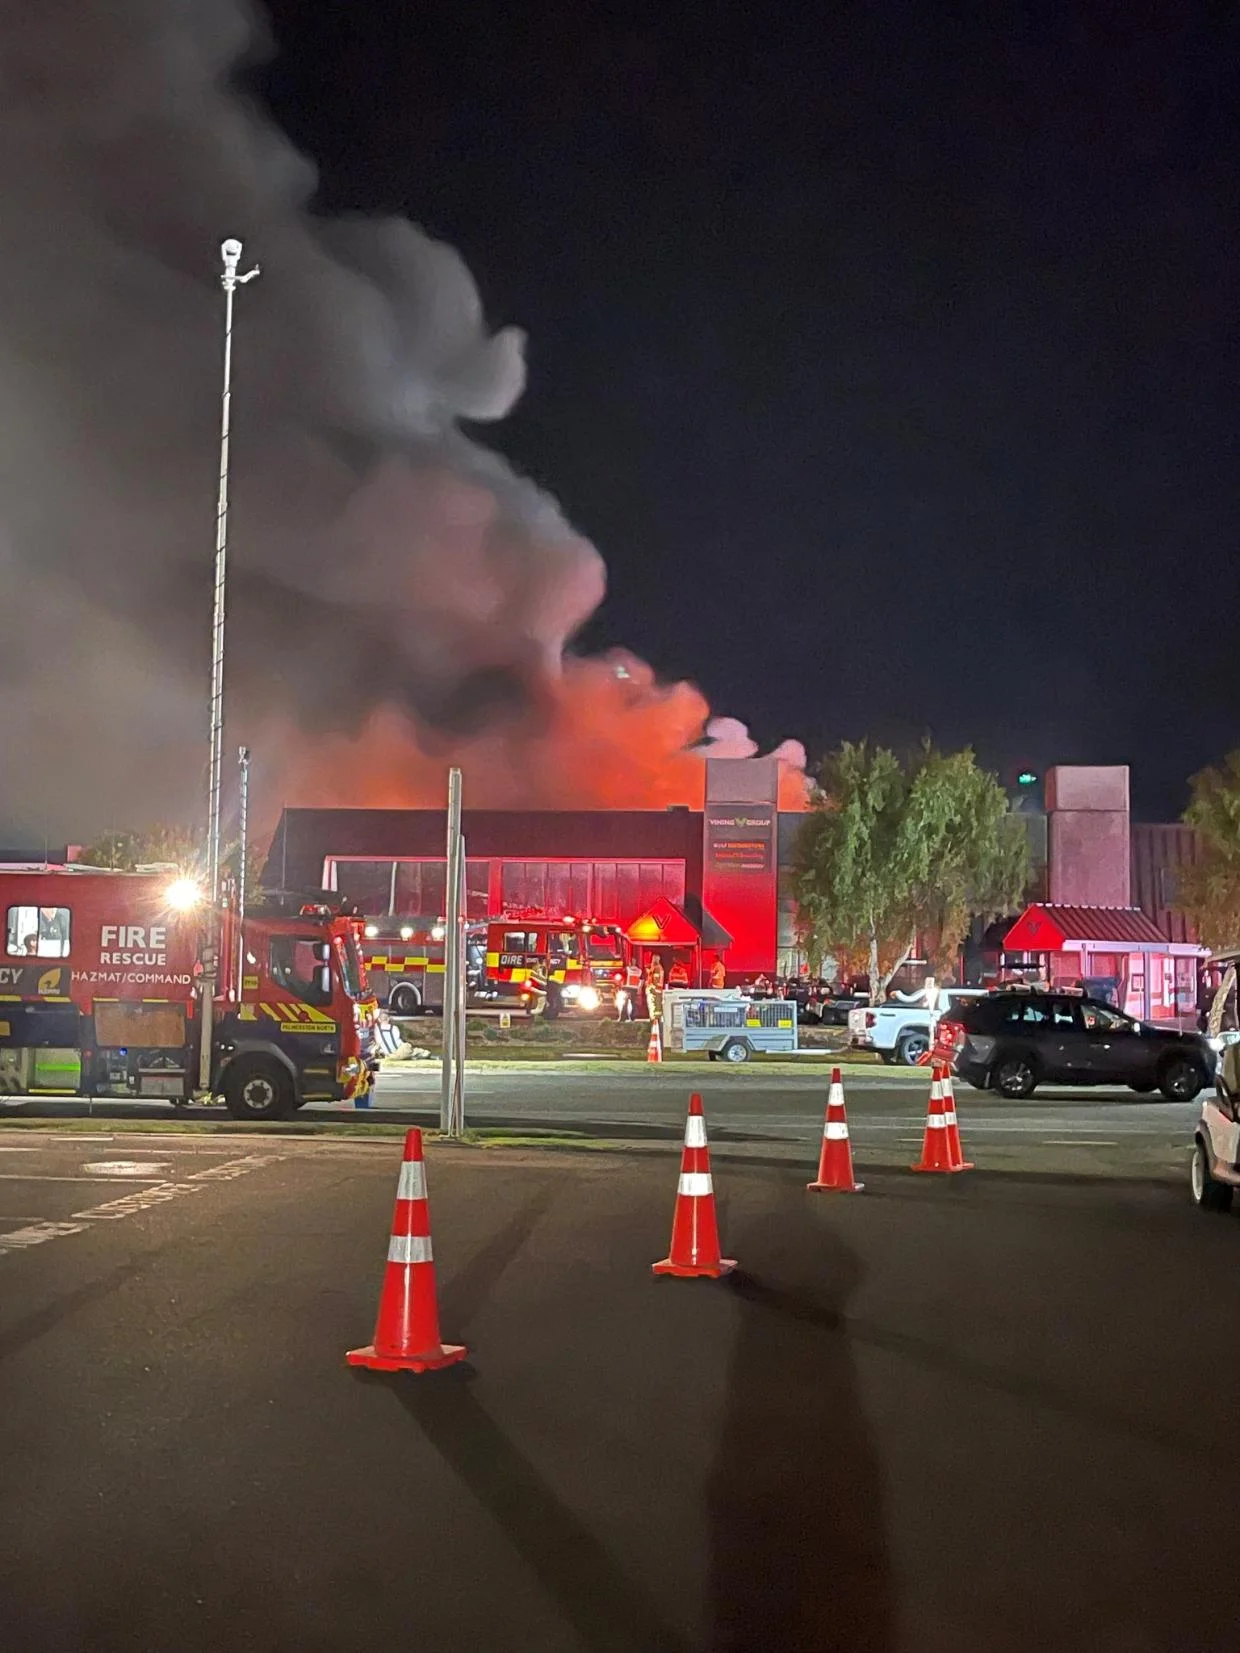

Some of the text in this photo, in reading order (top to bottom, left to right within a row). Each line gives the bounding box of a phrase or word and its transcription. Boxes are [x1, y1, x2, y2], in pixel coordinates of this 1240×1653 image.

[101, 925, 166, 949] FIRE
[100, 952, 167, 966] RESCUE
[71, 970, 192, 985] HAZMAT/COMMAND
